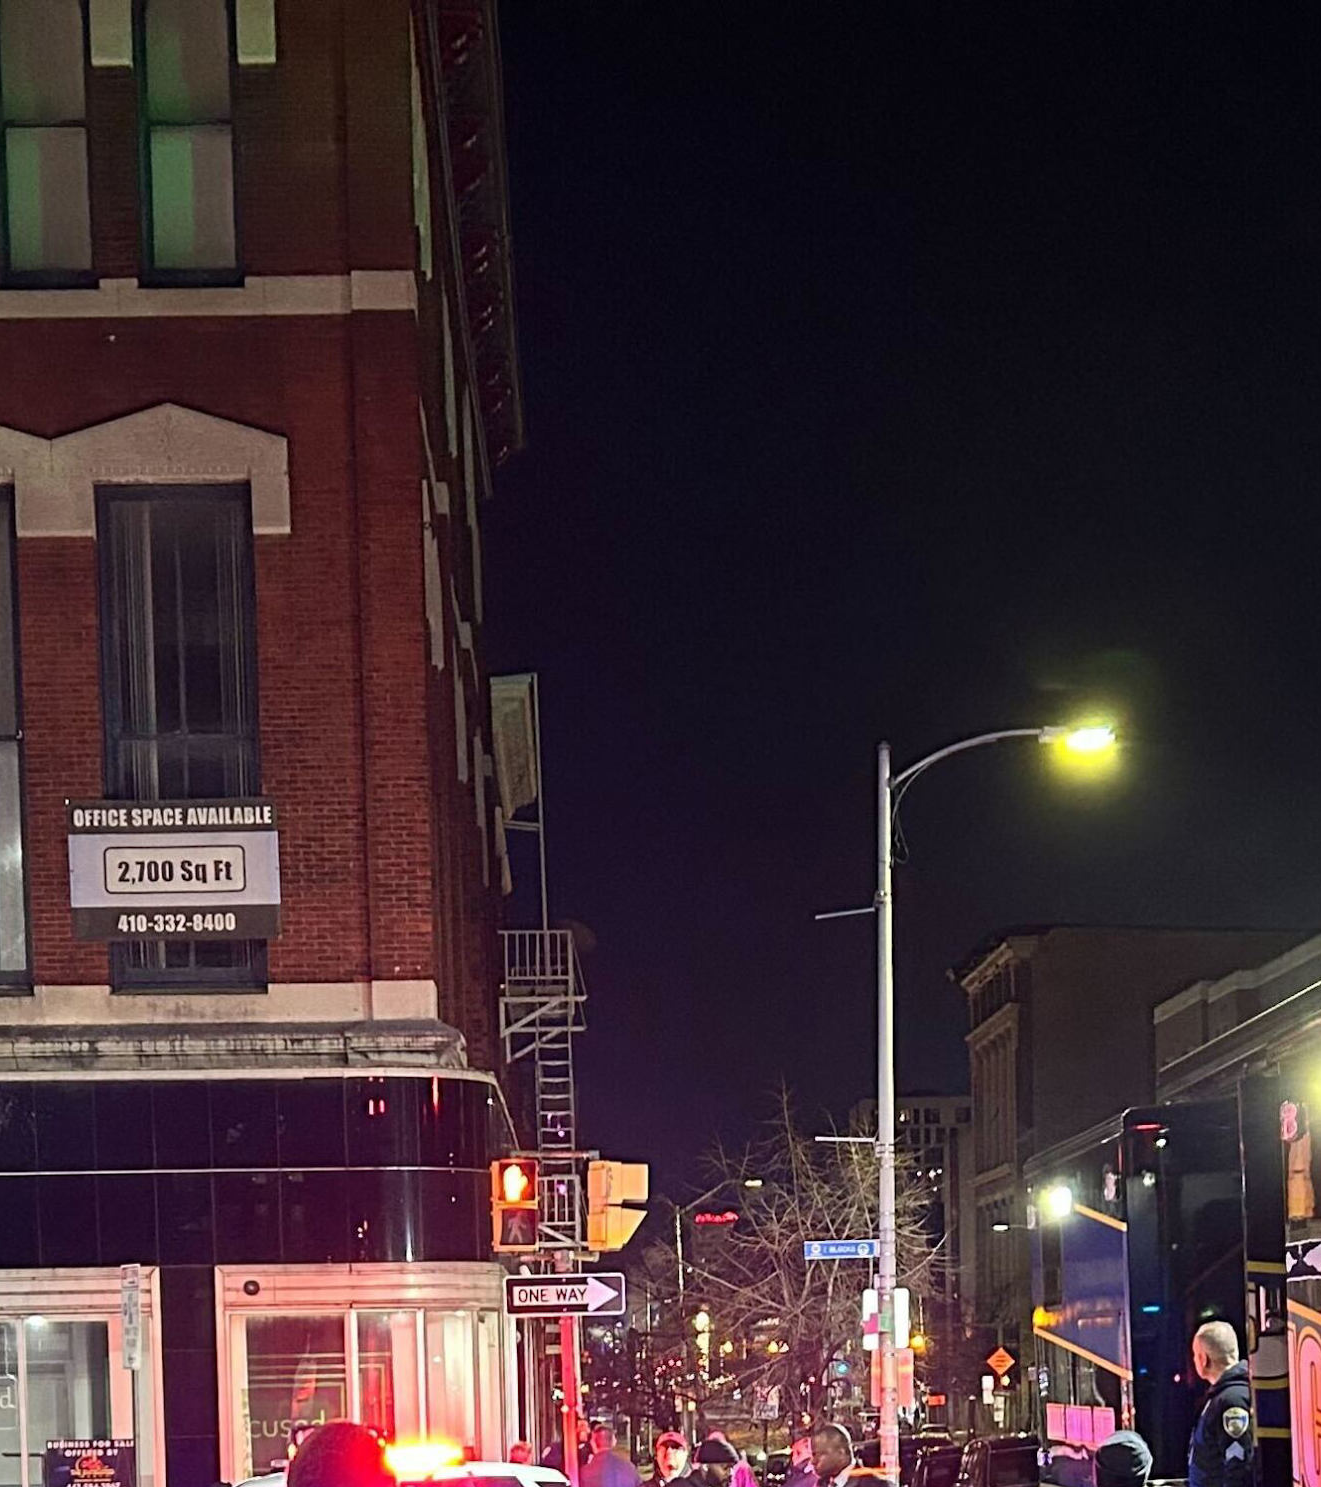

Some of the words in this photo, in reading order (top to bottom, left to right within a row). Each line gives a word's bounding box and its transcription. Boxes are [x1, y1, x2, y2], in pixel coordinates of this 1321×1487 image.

[73, 809, 127, 827] OFFICE
[131, 808, 183, 826] SPACE
[187, 806, 272, 825] AVAILABLE
[118, 861, 173, 884] 2,700
[181, 860, 206, 884] Sq
[214, 860, 232, 881] Ft
[118, 913, 236, 932] 410-332-8400
[518, 1289, 549, 1302] ONE
[556, 1288, 586, 1301] WAY
